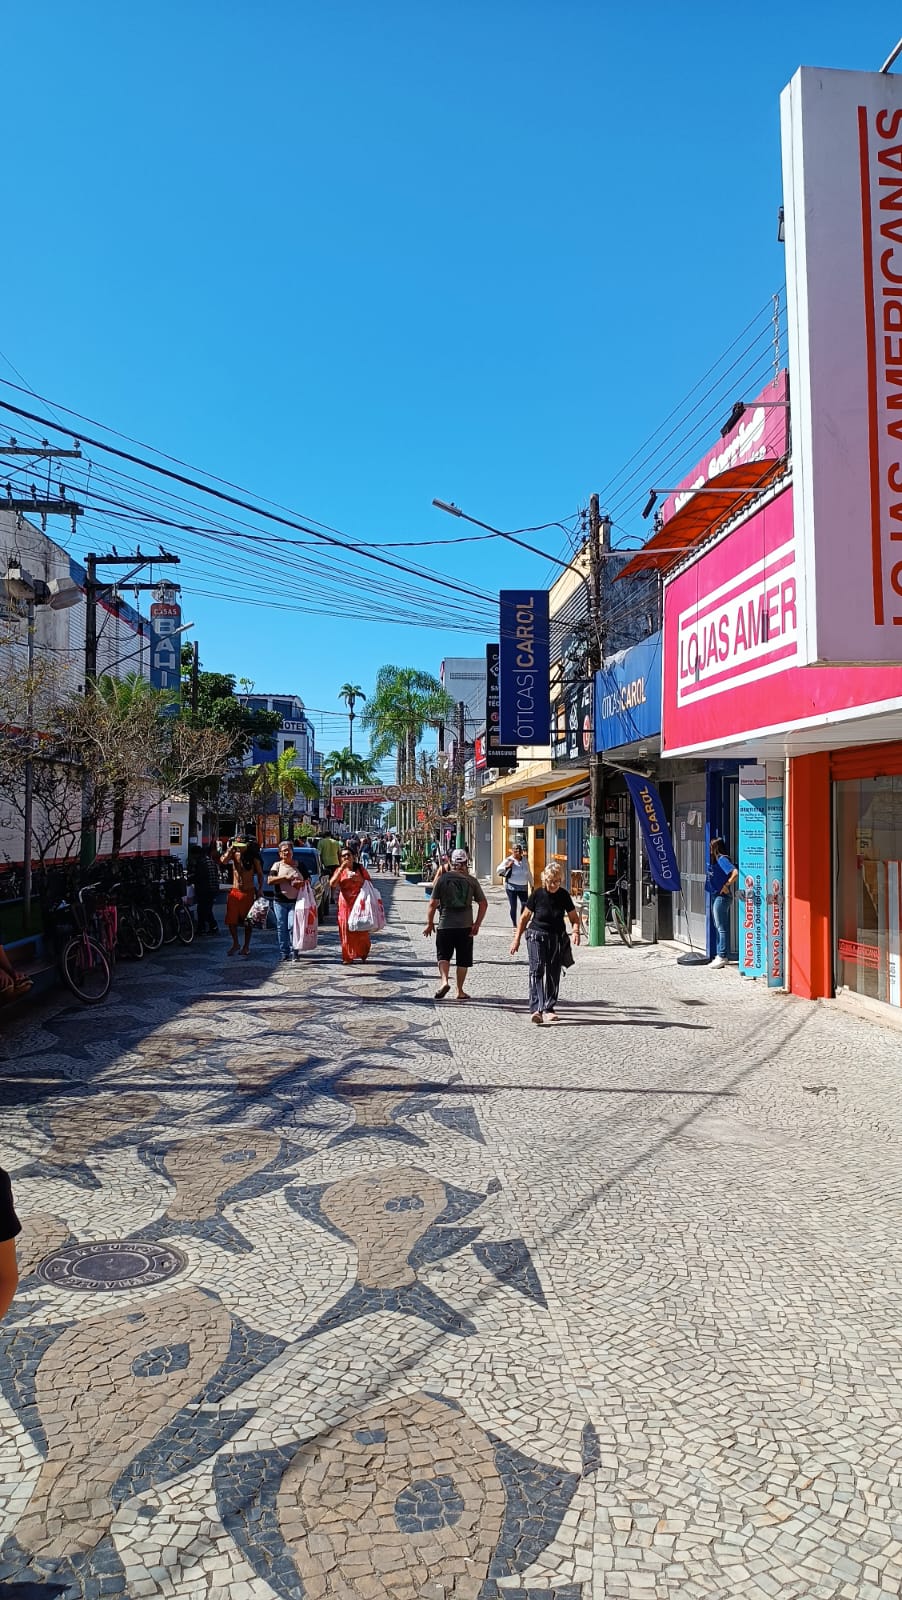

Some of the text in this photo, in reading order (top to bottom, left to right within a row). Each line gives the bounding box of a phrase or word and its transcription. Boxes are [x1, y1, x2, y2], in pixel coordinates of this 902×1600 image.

[153, 618, 176, 687] BAHI
[513, 596, 535, 738] ÓTICAS CAROL
[681, 614, 730, 679] LOJAS
[602, 690, 620, 719] ÓTICAS
[621, 677, 647, 710] CAROL
[335, 788, 365, 796] DENGUE
[640, 785, 672, 879] ÓTICAS CAROL
